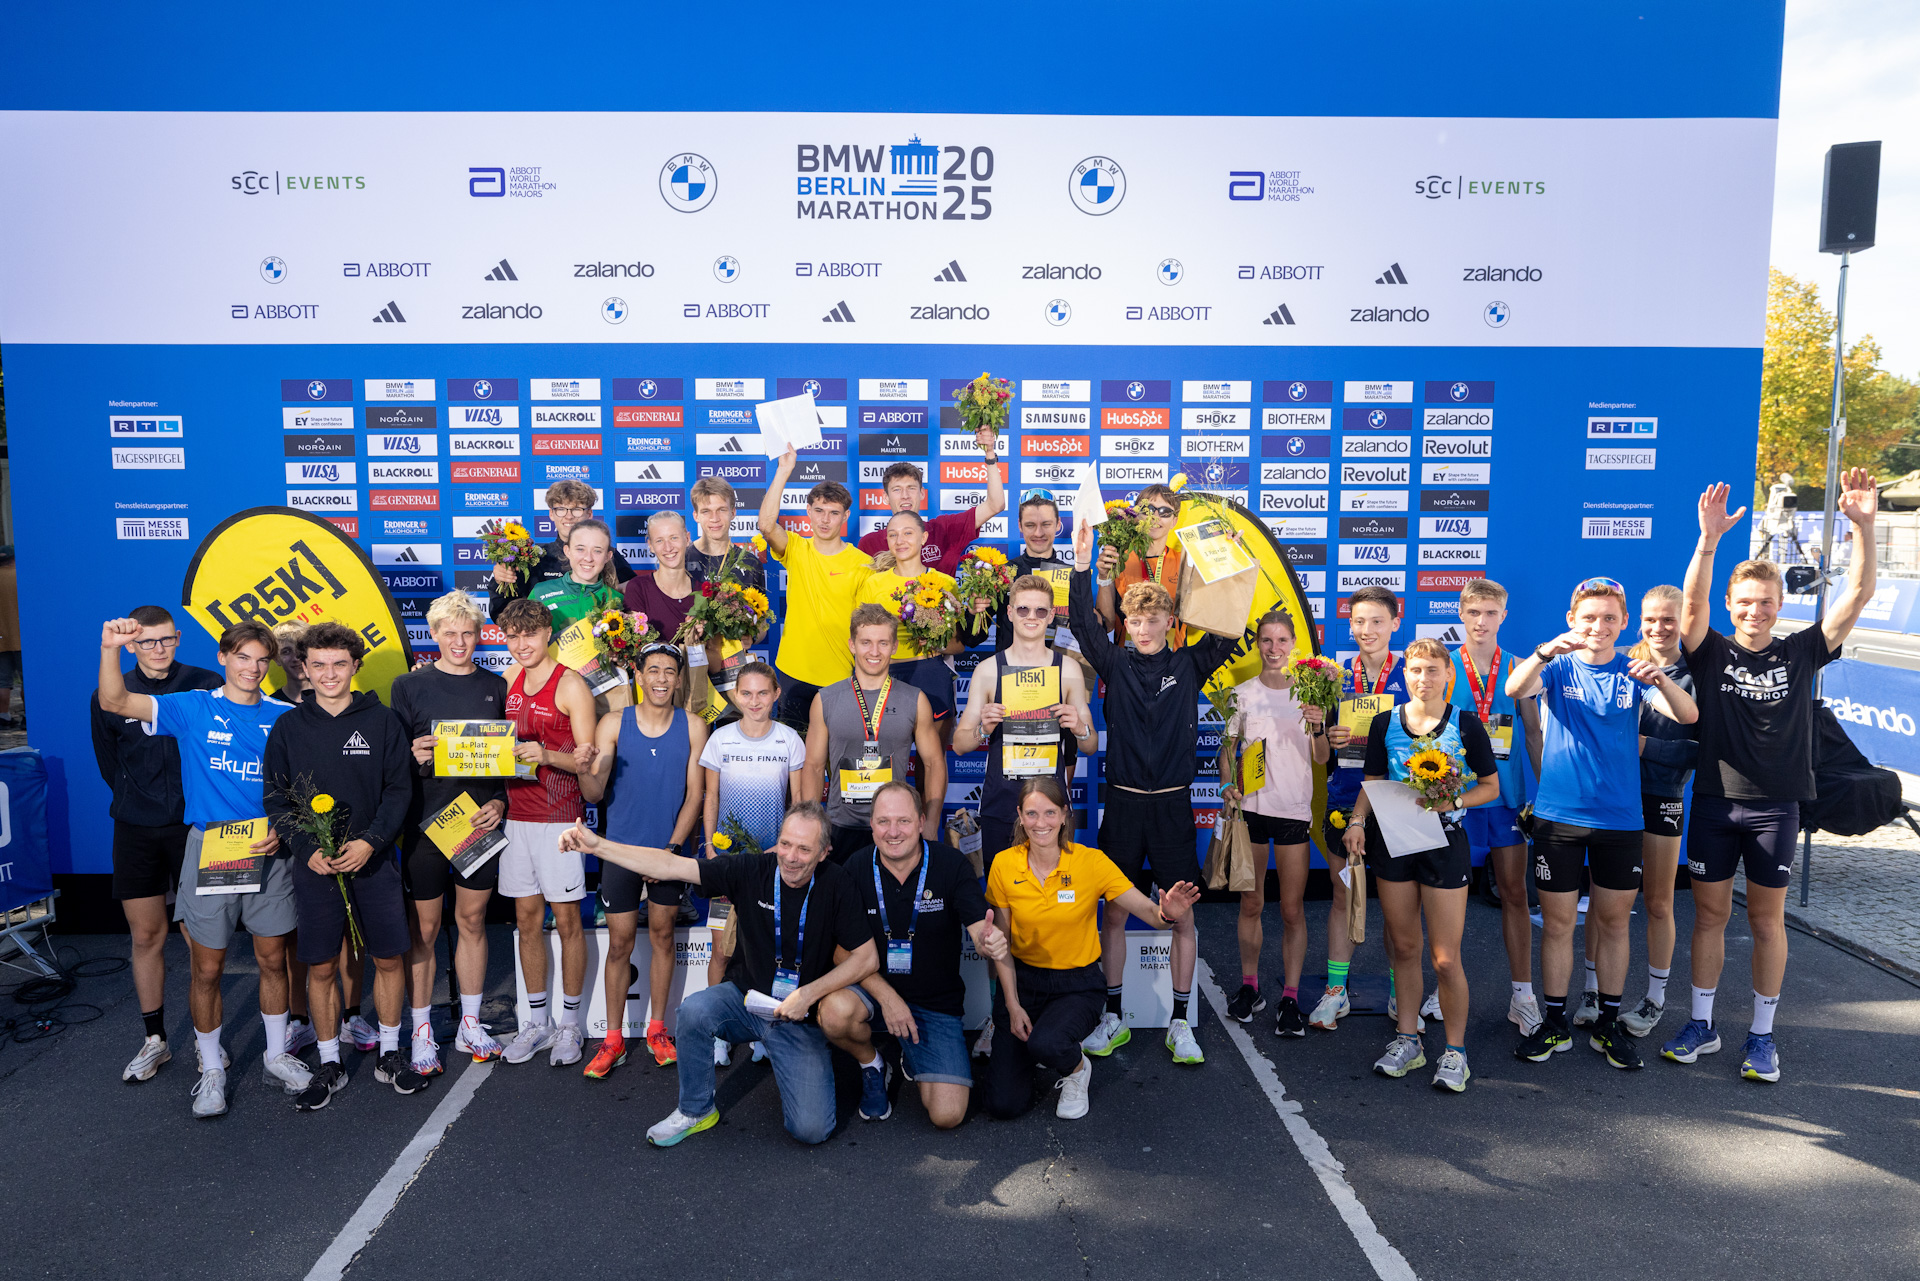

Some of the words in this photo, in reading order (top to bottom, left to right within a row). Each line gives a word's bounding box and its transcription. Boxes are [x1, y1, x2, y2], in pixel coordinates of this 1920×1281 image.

[798, 145, 886, 172] BMW
[944, 146, 994, 181] 20
[510, 167, 541, 176] ABBOTT
[1269, 171, 1300, 179] ABBOTT
[287, 176, 366, 189] EVENTS
[510, 174, 541, 184] WORLD
[1269, 179, 1300, 187] WORLD
[510, 182, 556, 191] MARATHON
[1269, 186, 1314, 195] MARATHON
[1468, 181, 1544, 194] EVENTS
[798, 177, 886, 195] BERLIN
[943, 186, 994, 220] 25
[798, 201, 936, 220] MARATHON
[366, 263, 431, 277] ABBOTT
[573, 262, 654, 277] zalando
[818, 263, 882, 276] ABBOTT
[1022, 264, 1101, 279] zalando
[1260, 266, 1324, 280] ABBOTT
[1463, 266, 1543, 281] zalando
[254, 305, 319, 318] ABBOTT
[462, 303, 542, 319] zalando
[706, 304, 770, 318] ABBOTT
[911, 304, 989, 320] zalando
[1148, 307, 1212, 320] ABBOTT
[1351, 306, 1429, 322] zalando
[466, 409, 502, 426] VILSA
[536, 413, 595, 421] BLACKROLL
[632, 412, 680, 421] GENERALI
[709, 410, 744, 419] ERDINGER
[879, 412, 923, 422] ABBOTT
[1026, 414, 1085, 423] SAMSUNG
[1108, 410, 1162, 427] HubSpot
[1196, 414, 1236, 423] SHOKZ
[1268, 414, 1325, 424] BIOTHERM
[1427, 413, 1489, 425] zalando
[118, 422, 176, 431] RTL
[296, 418, 308, 426] EY
[1595, 423, 1649, 432] RTL
[384, 437, 420, 454] VILSA
[455, 441, 514, 449] BLACKROLL
[550, 440, 598, 449] GENERALI
[628, 438, 663, 446] ERDINGER
[1028, 438, 1082, 454] HubSpot
[1115, 442, 1154, 450] SHOKZ
[1187, 441, 1243, 451] BIOTHERM
[1345, 440, 1408, 452] zalando
[1426, 440, 1488, 454] Revolut
[115, 454, 182, 463] TAGESSPIEGEL
[1589, 454, 1652, 464] TAGESSPIEGEL
[302, 465, 339, 482] VILSA
[374, 468, 432, 477] BLACKROLL
[469, 468, 517, 477] GENERALI
[546, 465, 582, 474] ERDINGER
[716, 467, 761, 478] ABBOTT
[1035, 468, 1074, 478] SHOKZ
[1106, 468, 1162, 478] BIOTHERM
[1264, 467, 1326, 479] zalando
[1344, 467, 1406, 481] Revolut
[1433, 473, 1446, 482] EY
[292, 496, 351, 504] BLACKROLL
[388, 496, 436, 504] GENERALI
[465, 493, 501, 502] ERDINGER
[635, 494, 680, 504] ABBOTT
[1263, 494, 1325, 508] Revolut
[1352, 500, 1364, 508] EY
[384, 520, 420, 530] ERDINGER
[1436, 520, 1471, 536] VILSA
[1355, 547, 1390, 563] VILSA
[1423, 550, 1480, 558] BLACKROLL
[393, 577, 438, 586] ABBOTT
[1342, 578, 1399, 587] BLACKROLL
[1724, 664, 1788, 687] ACTIVE
[1720, 683, 1789, 700] SPORTSHOP
[1010, 708, 1051, 720] URKUNDE
[1822, 696, 1916, 736] zalando
[1024, 748, 1037, 757] 27
[859, 772, 870, 781] 14
[209, 859, 255, 870] URKUNDE
[676, 942, 704, 951] BMW
[1141, 946, 1169, 955] BMW
